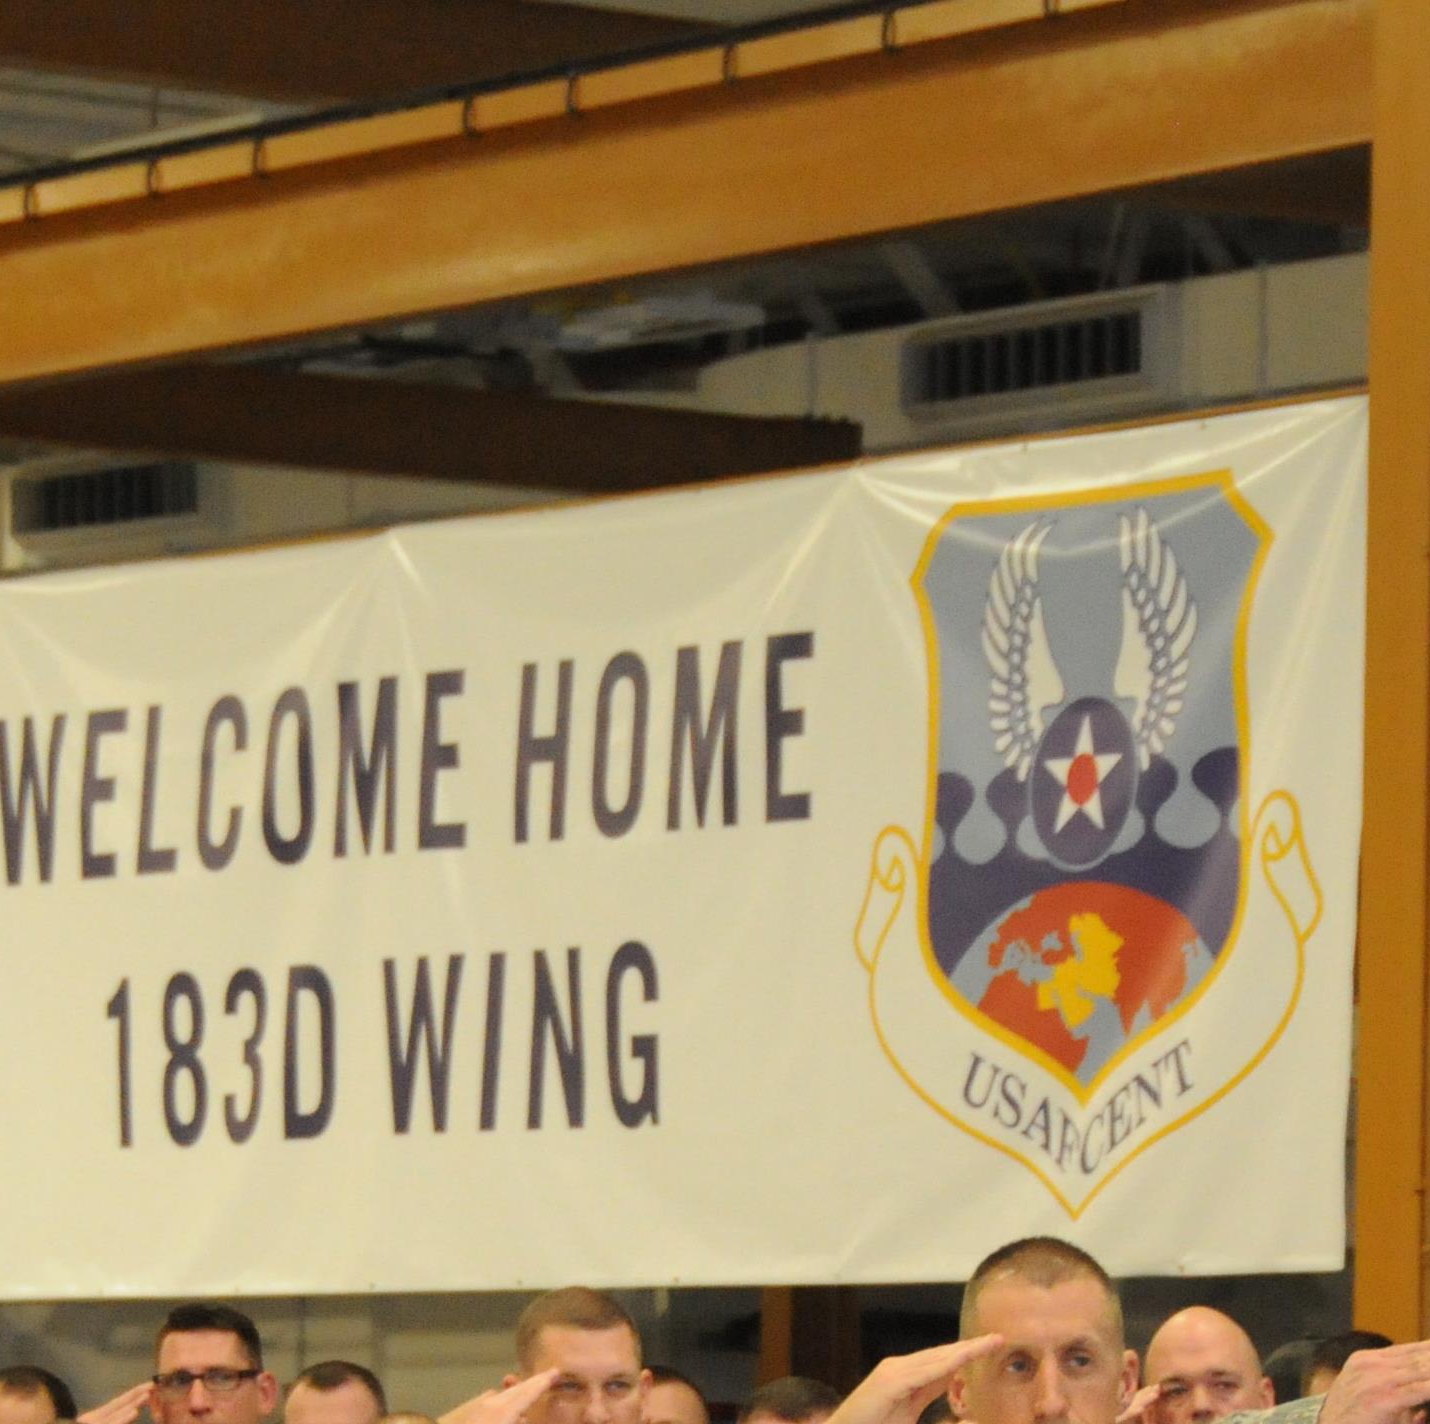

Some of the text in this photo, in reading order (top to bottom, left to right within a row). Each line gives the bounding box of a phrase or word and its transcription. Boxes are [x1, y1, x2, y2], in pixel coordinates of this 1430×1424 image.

[513, 631, 815, 844] HOME
[106, 940, 661, 1148] 183D WING
[962, 1040, 1195, 1176] USAFCENT
